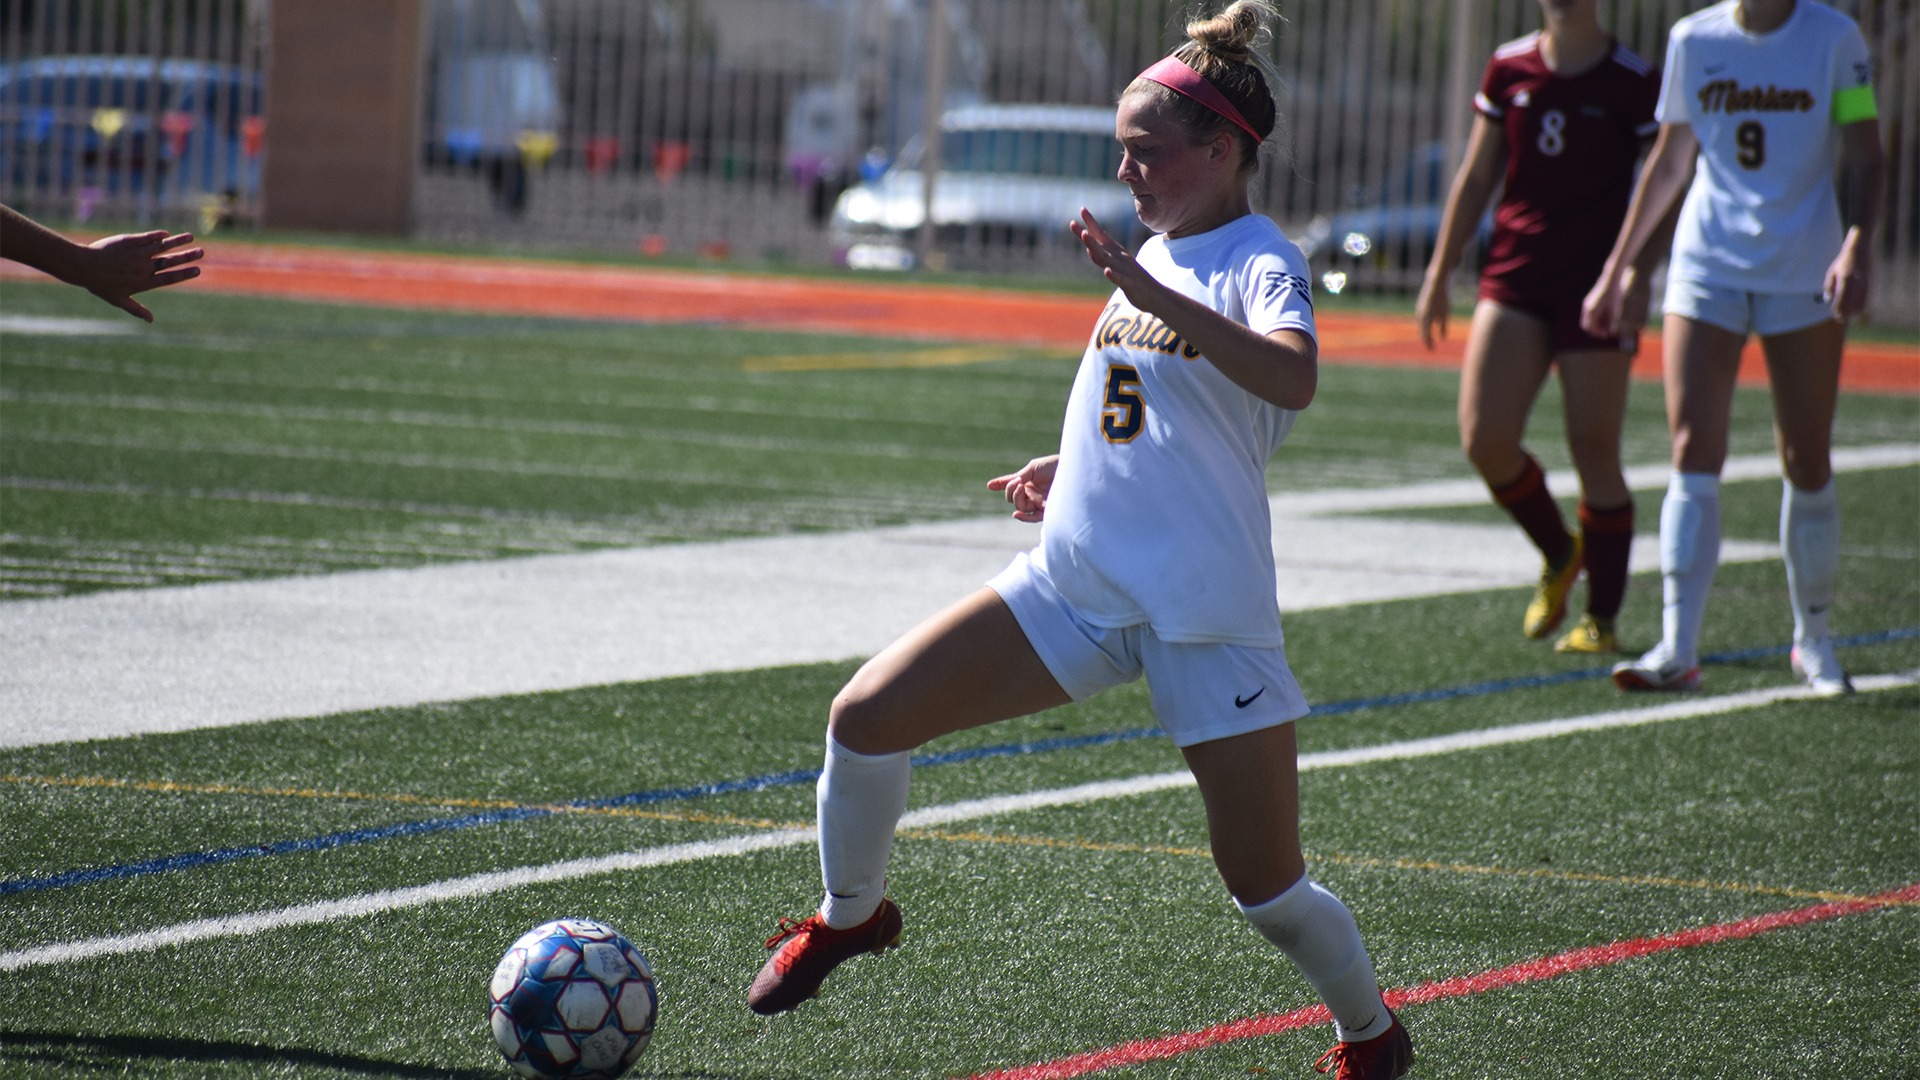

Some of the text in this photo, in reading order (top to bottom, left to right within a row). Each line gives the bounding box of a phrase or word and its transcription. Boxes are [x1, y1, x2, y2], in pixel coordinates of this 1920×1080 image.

[1698, 79, 1815, 115] Marian
[1537, 110, 1565, 156] 8
[1736, 121, 1766, 170] 9
[1101, 363, 1146, 444] 5
